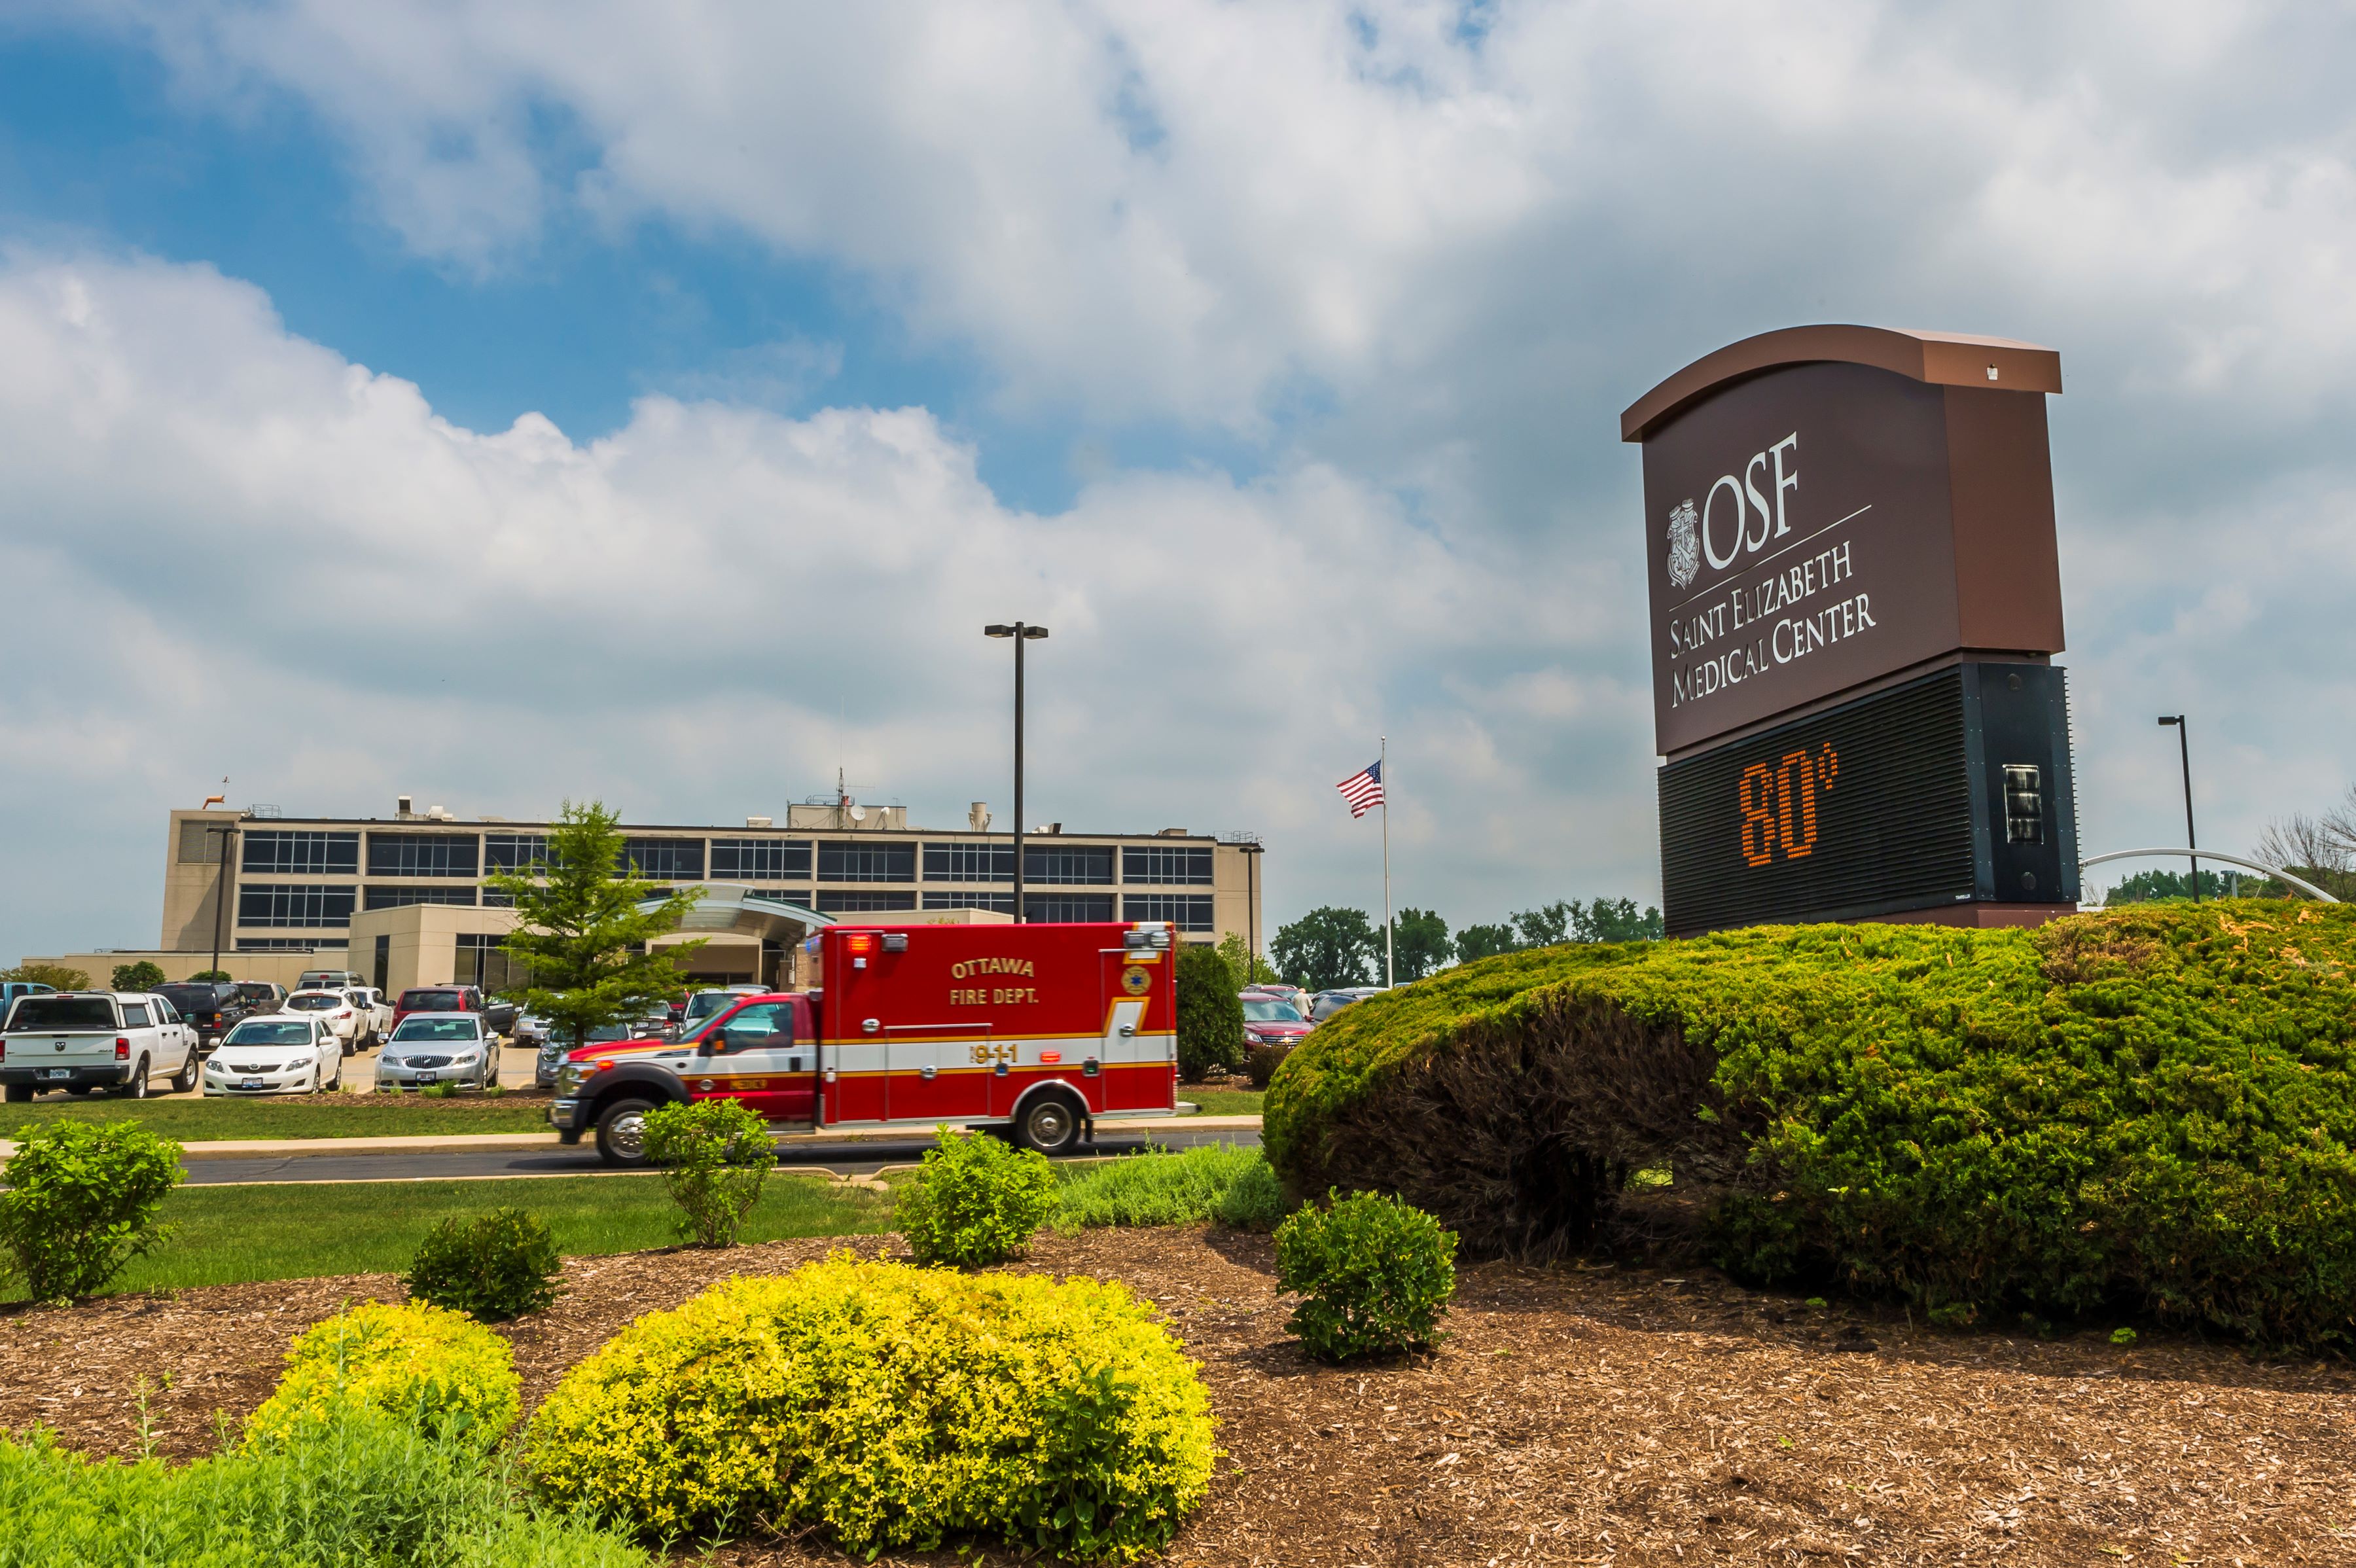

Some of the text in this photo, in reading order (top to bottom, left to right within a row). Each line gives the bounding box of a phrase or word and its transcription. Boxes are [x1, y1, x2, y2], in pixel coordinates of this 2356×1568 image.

[1702, 431, 1798, 570] OSF
[1732, 541, 1853, 630] ELIZABETH
[1671, 593, 1876, 708] MEDICAL CENTER
[950, 988, 1039, 1005] FIRE DEPT.
[951, 957, 1035, 979] OTTAWA
